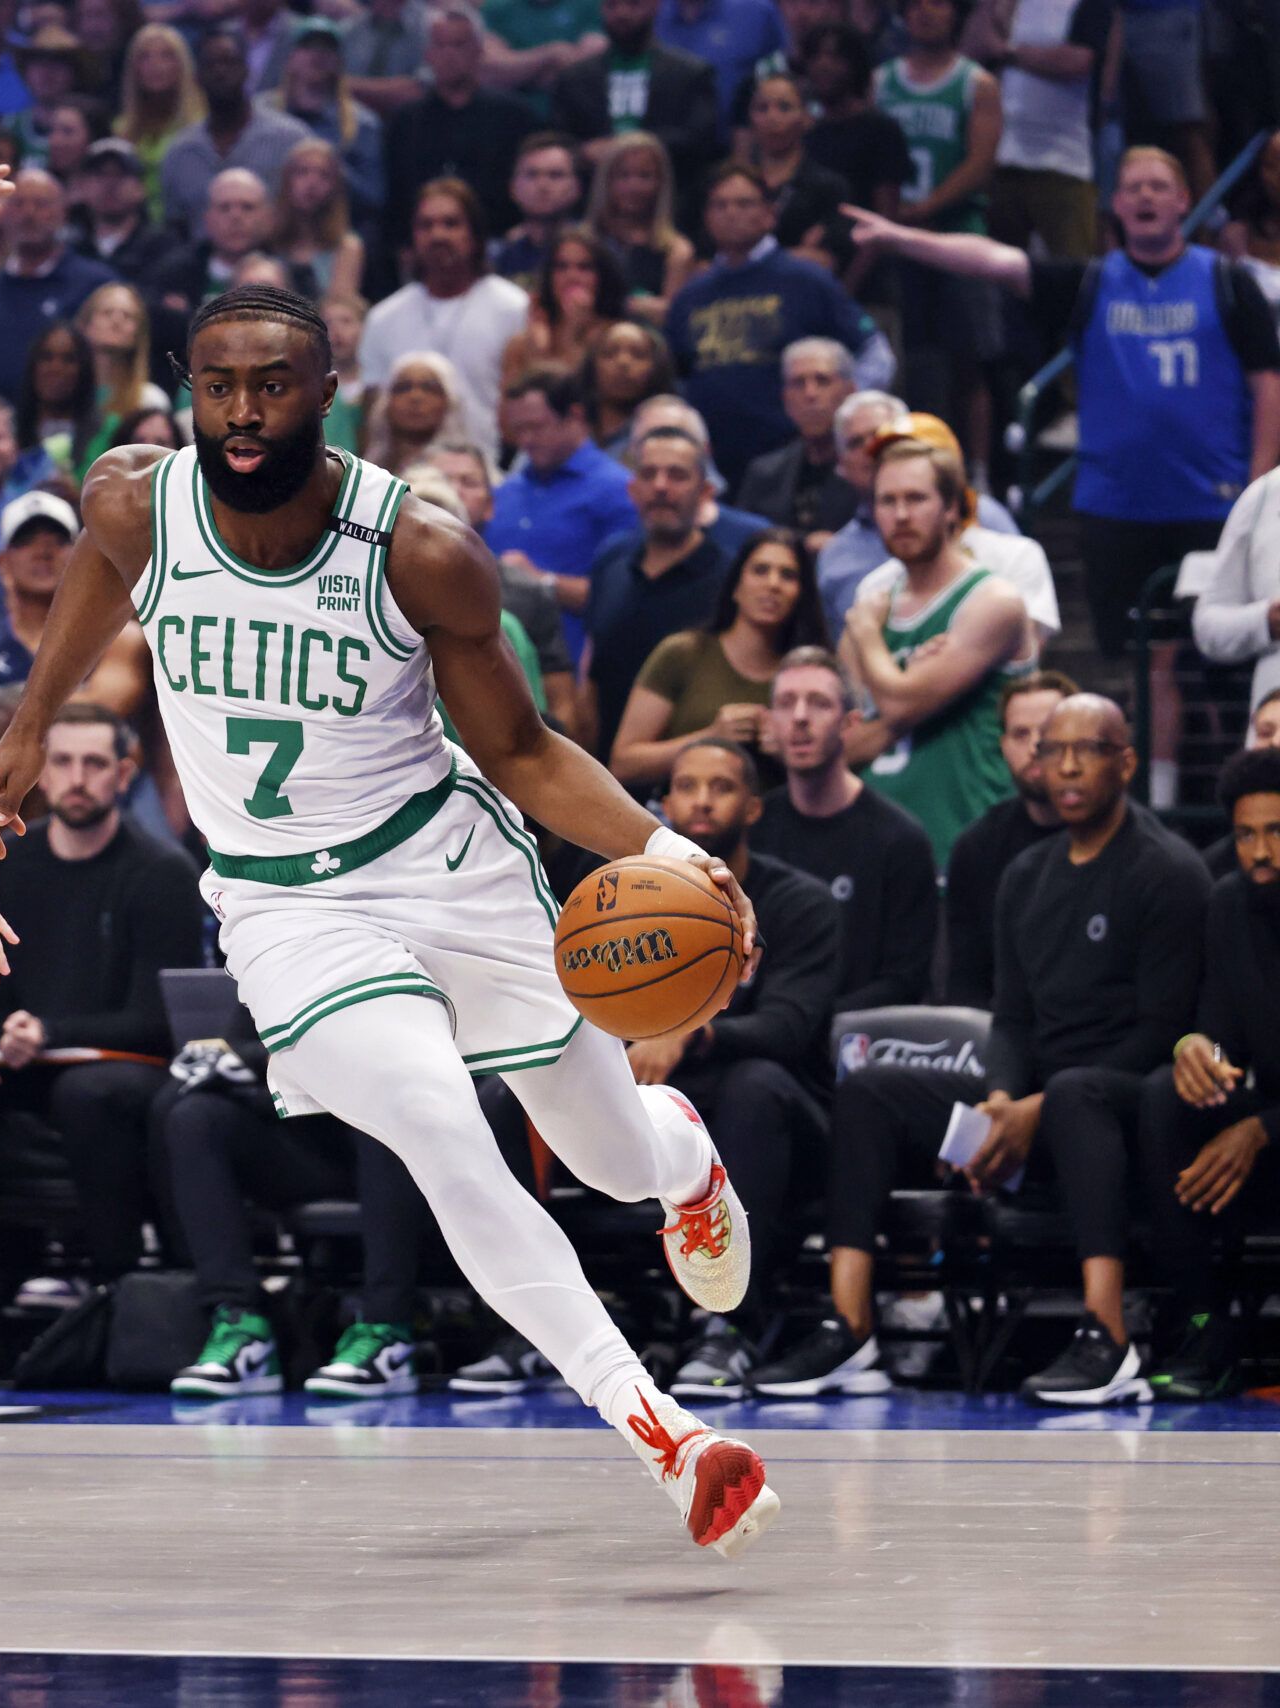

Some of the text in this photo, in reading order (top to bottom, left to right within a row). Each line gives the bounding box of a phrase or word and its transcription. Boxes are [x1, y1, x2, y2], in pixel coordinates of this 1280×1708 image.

[1147, 339, 1198, 388] 77
[339, 521, 380, 543] WALTON
[317, 596, 360, 612] PRINT
[318, 575, 360, 597] VISTA
[158, 615, 370, 716] CELTICS
[226, 716, 304, 820] 7
[563, 928, 678, 974] Wilson
